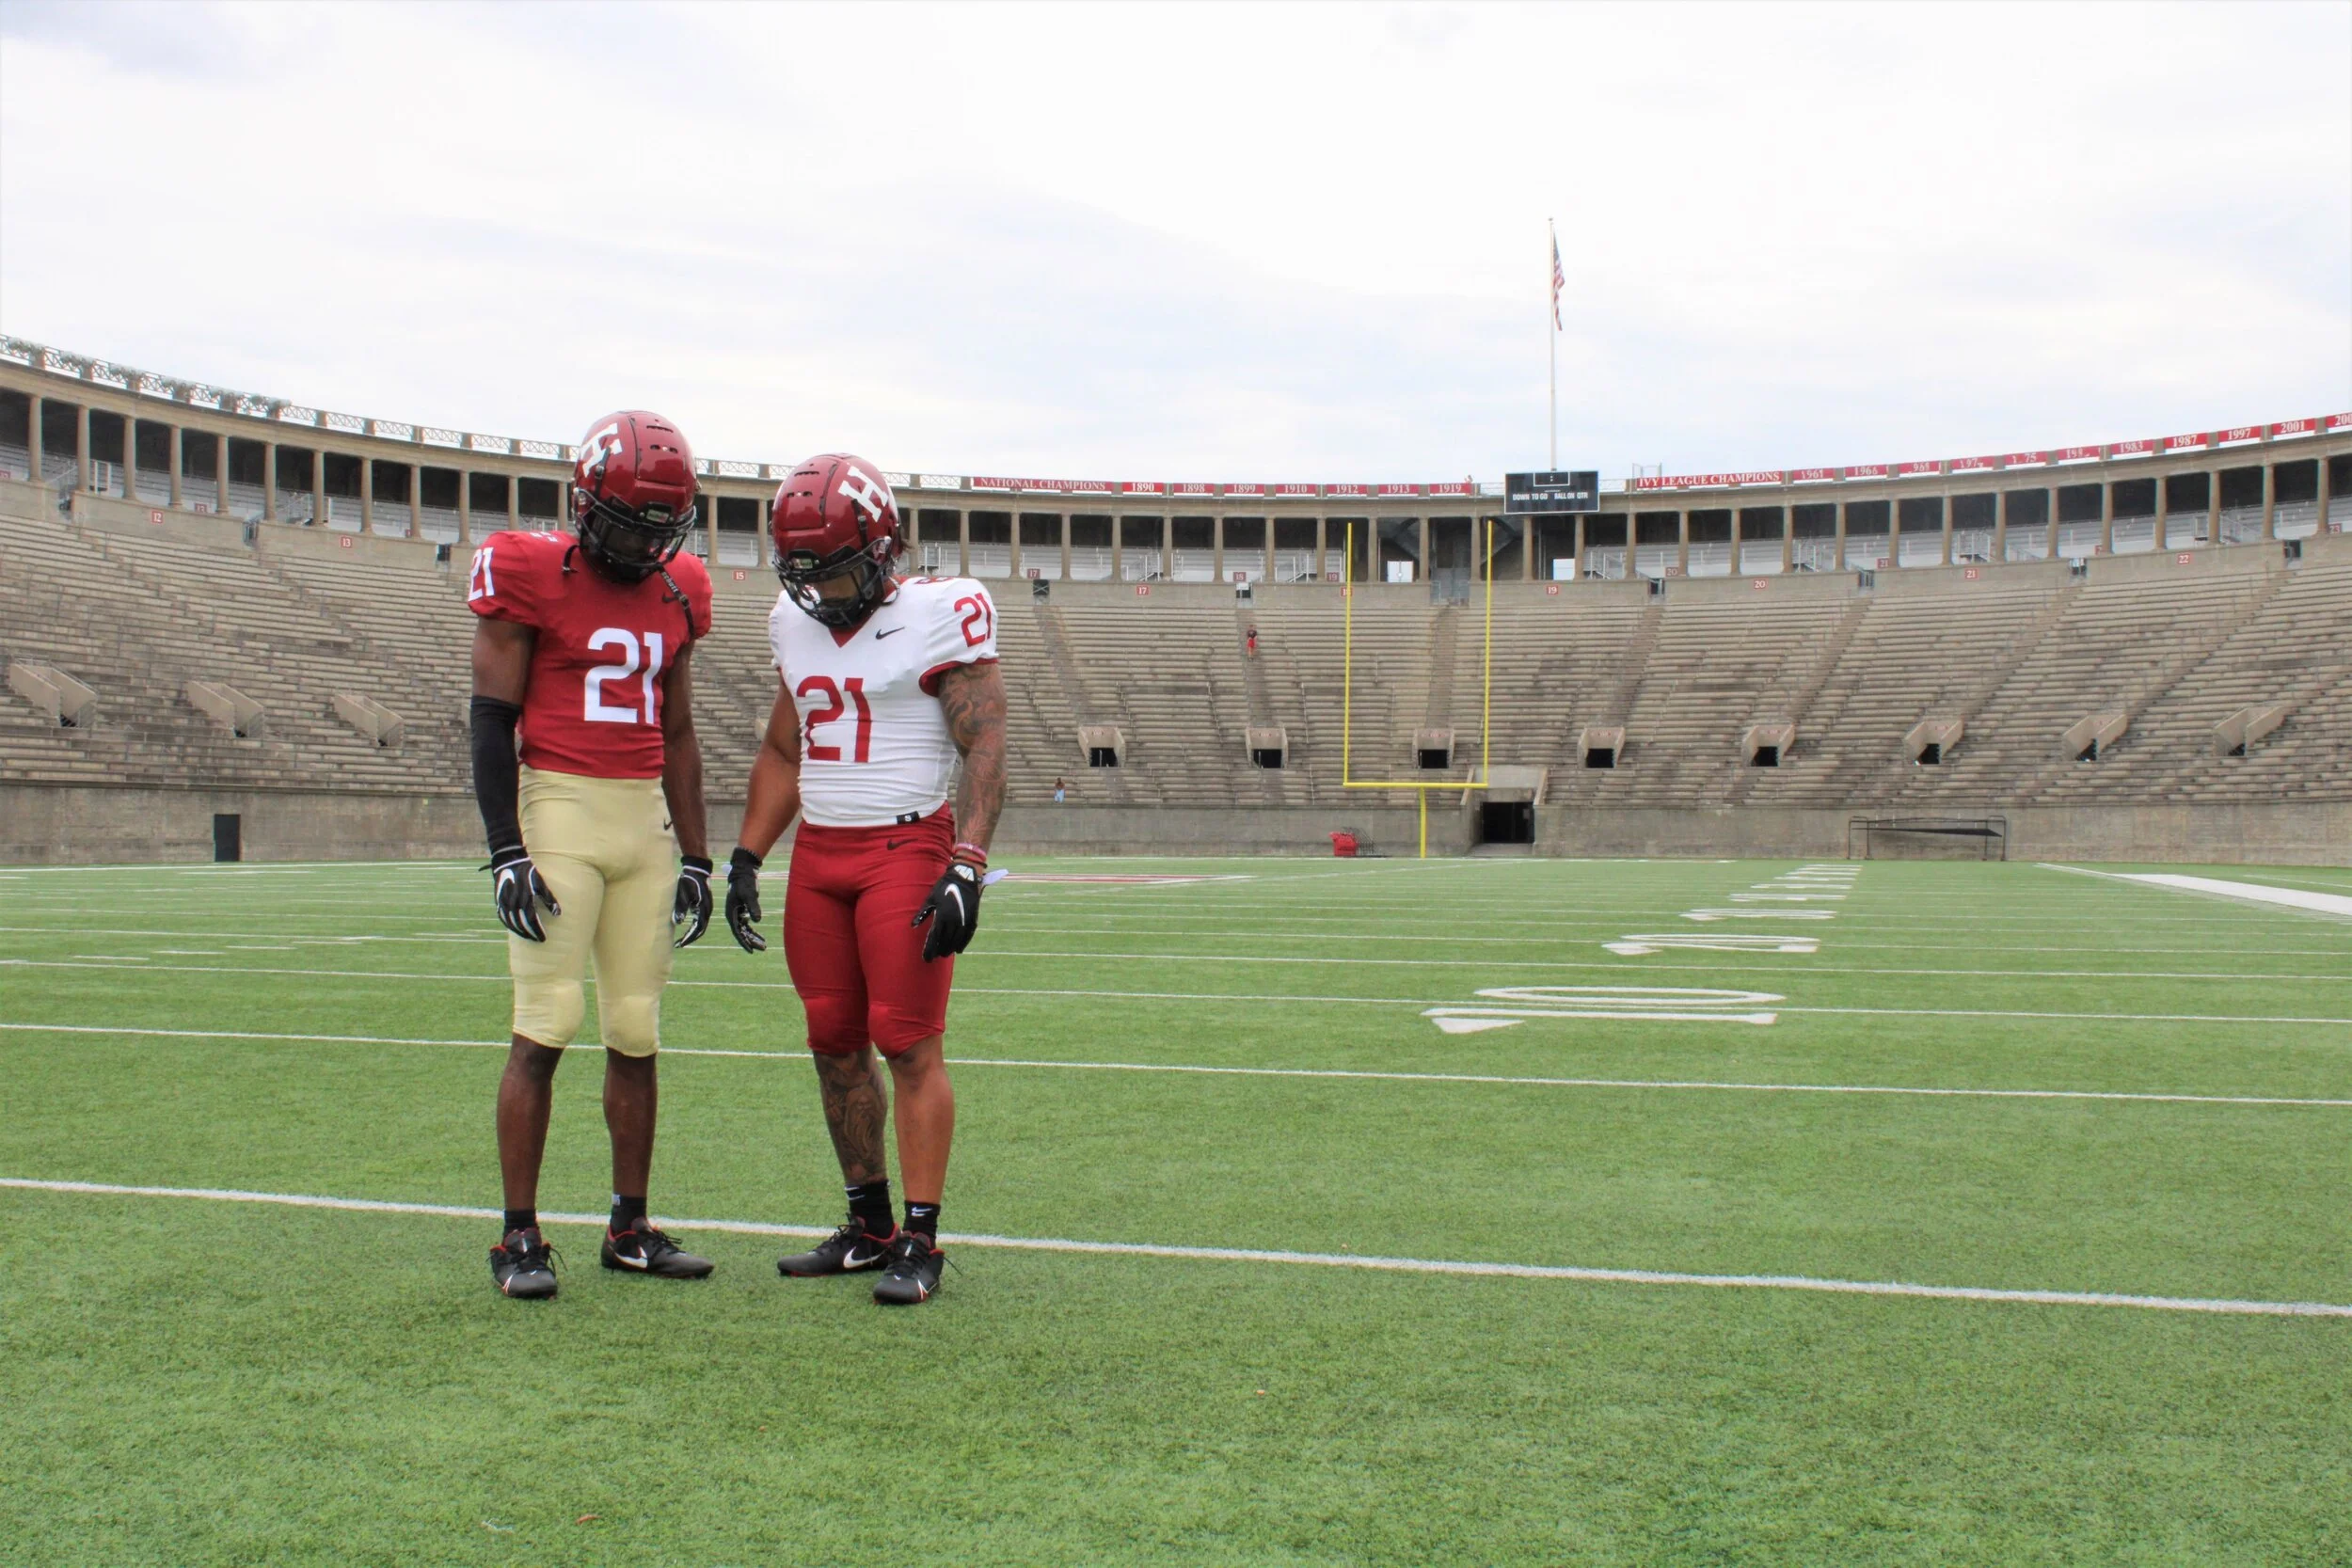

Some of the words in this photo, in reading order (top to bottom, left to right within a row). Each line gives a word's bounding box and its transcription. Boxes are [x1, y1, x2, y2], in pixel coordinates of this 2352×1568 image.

[2280, 420, 2306, 434] 2001
[2227, 428, 2251, 440] 1997
[2172, 435, 2198, 447] 1987
[2119, 441, 2144, 453] 1983
[980, 477, 1037, 490] NATIONAL
[1039, 479, 1106, 492] CHAMPIONS
[1639, 477, 1658, 488] IVY
[1661, 475, 1708, 486] LEAGUE
[1709, 471, 1780, 486] CHAMPIONS
[1131, 482, 1155, 492] 1890
[1183, 483, 1205, 493] 1898
[1232, 483, 1256, 494] 1899
[1284, 483, 1308, 494] 1910
[1335, 484, 1359, 494] 1912
[1387, 484, 1410, 494] 1913
[1438, 483, 1462, 494] 1919
[837, 466, 890, 523] H
[1512, 493, 1530, 501] DOWN
[153, 513, 162, 522] 12
[342, 538, 351, 546] 13
[2178, 554, 2189, 563] 22
[468, 546, 495, 602] 21
[736, 571, 744, 580] 15
[1029, 569, 1038, 578] 17
[1666, 567, 1677, 576] 20
[1966, 570, 1976, 578] 21
[1754, 579, 1766, 589] 20
[1137, 586, 1148, 595] 17
[1548, 586, 1557, 594] 19
[954, 593, 993, 647] 21
[583, 627, 663, 724] 21
[796, 676, 871, 763] 21
